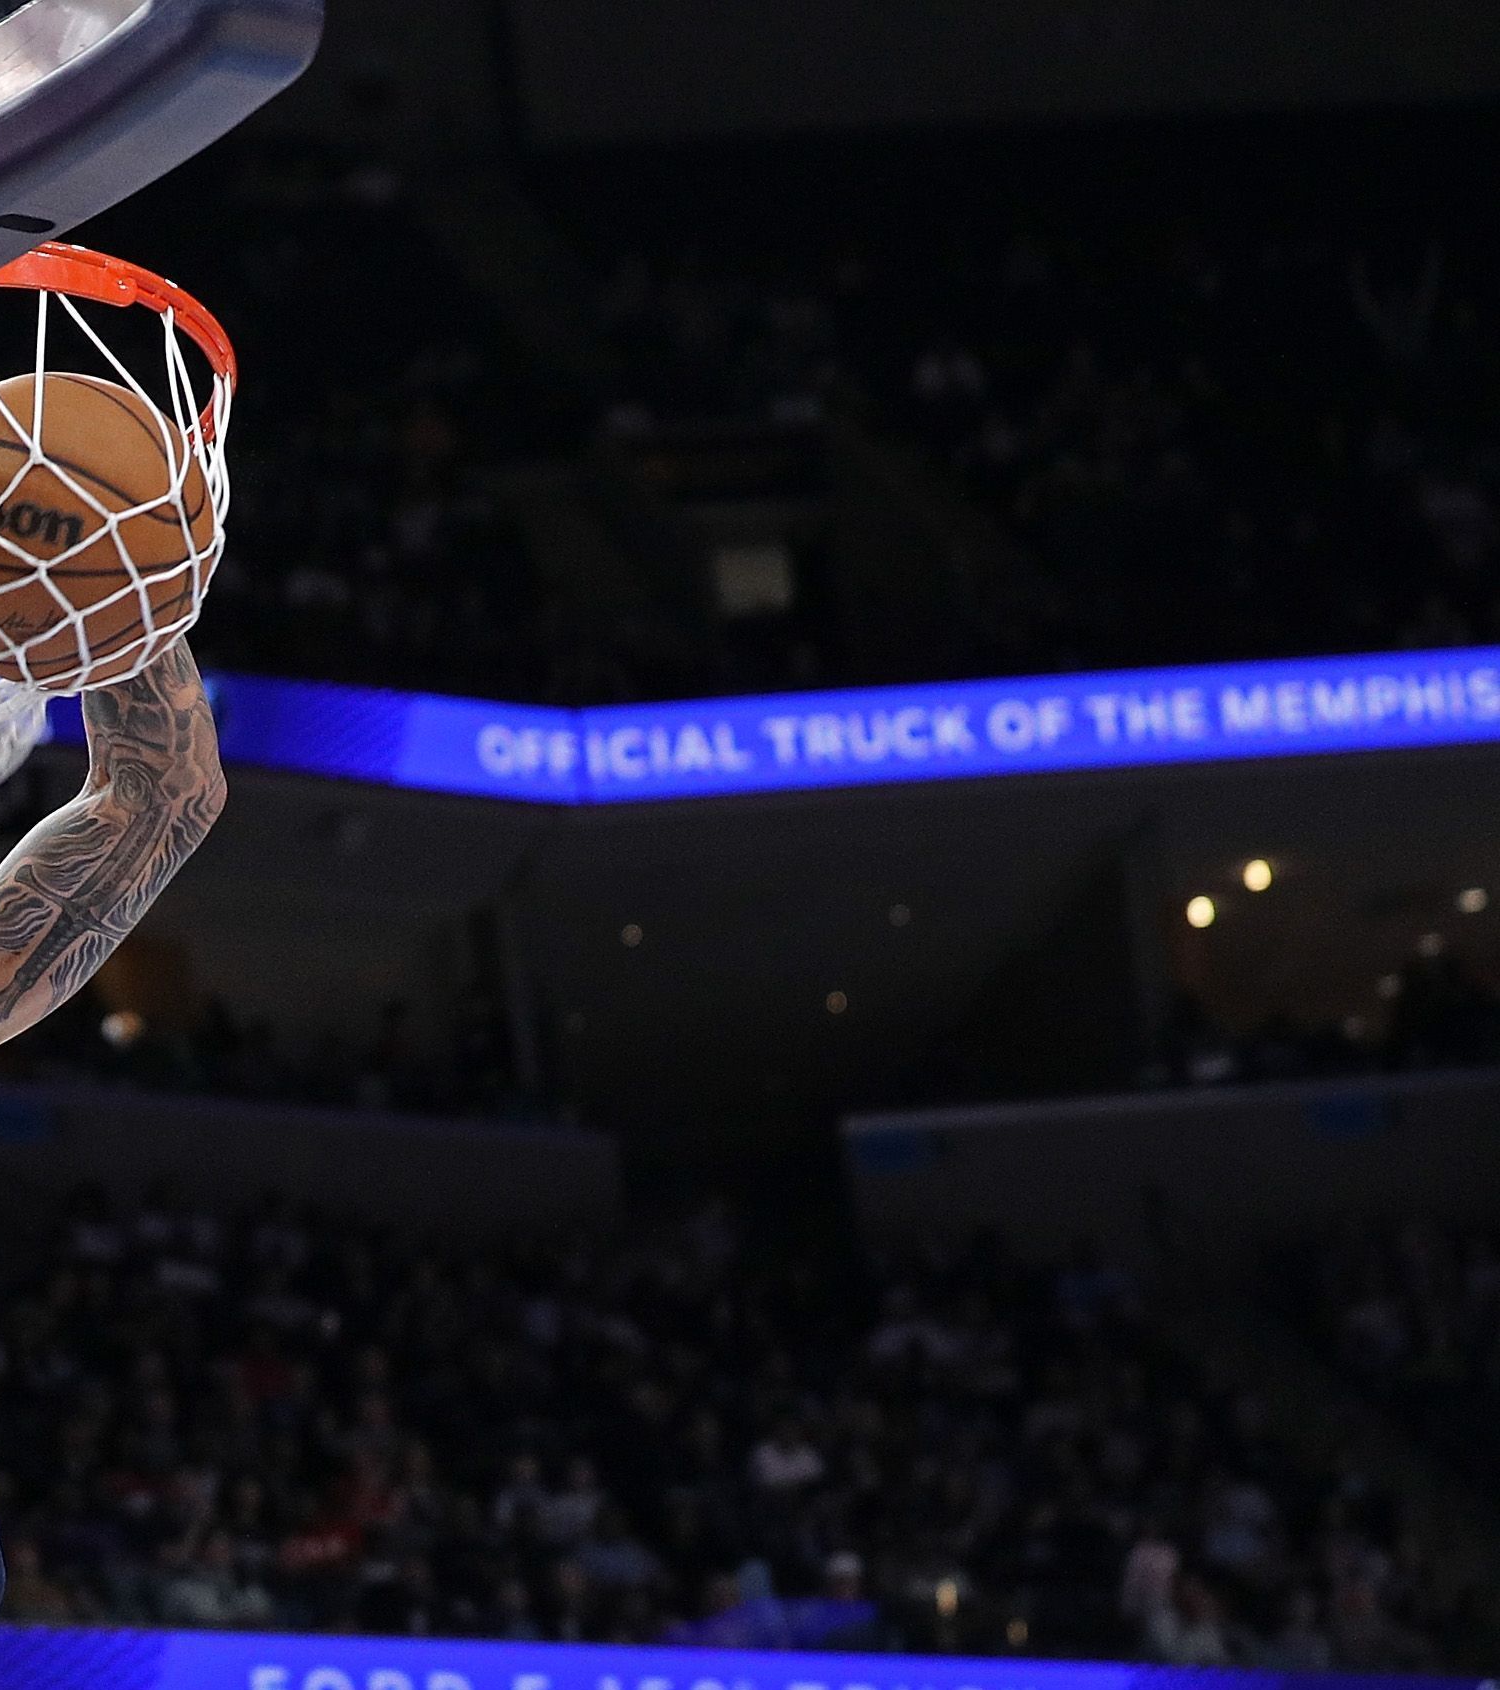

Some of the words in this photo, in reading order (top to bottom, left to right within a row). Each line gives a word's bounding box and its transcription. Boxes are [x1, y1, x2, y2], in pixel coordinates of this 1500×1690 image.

[475, 721, 752, 779] OFFICIAL
[760, 704, 977, 766] TRUCK
[986, 696, 1073, 753] OF
[1084, 686, 1207, 743] THE
[1218, 666, 1500, 735] MEMPHIS
